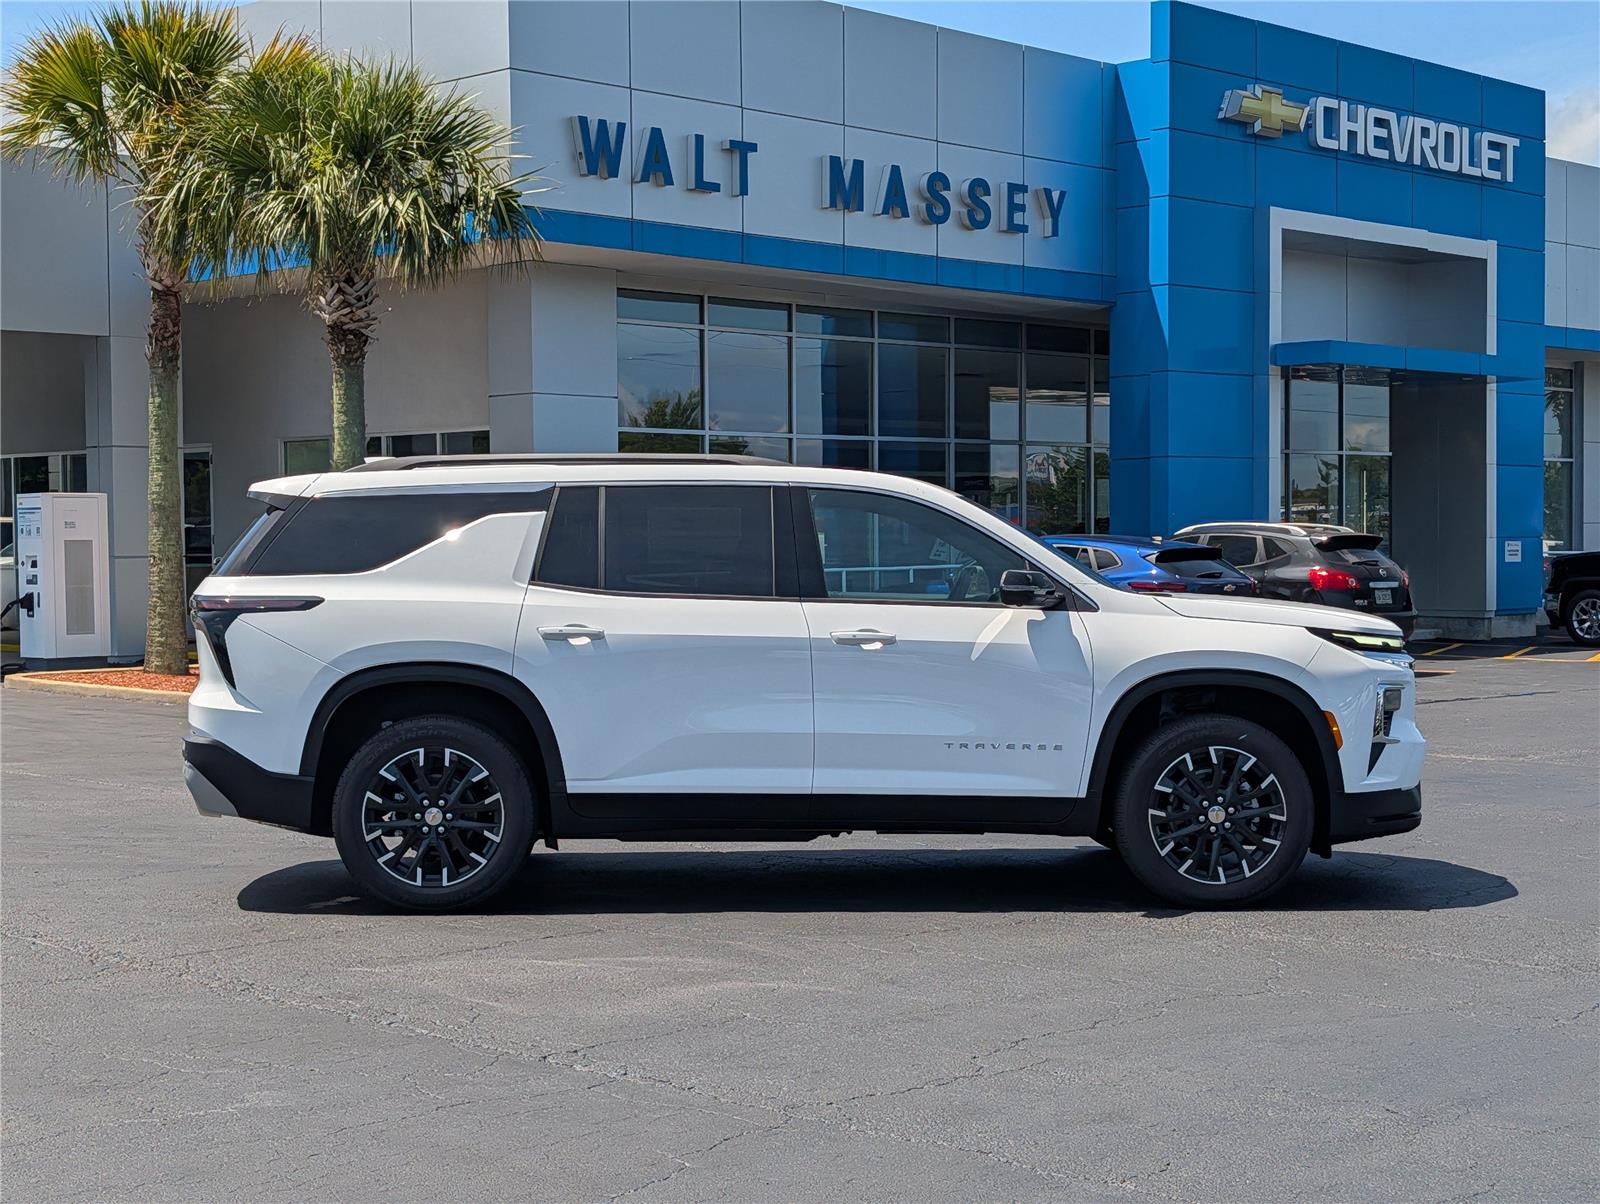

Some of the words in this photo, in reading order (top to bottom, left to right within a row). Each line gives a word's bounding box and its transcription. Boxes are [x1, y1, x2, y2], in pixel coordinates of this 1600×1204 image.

[571, 116, 758, 196] WALT
[821, 155, 1066, 238] MASSEY
[1311, 96, 1520, 182] CHEVROLET
[944, 742, 1064, 751] TRAVERSE
